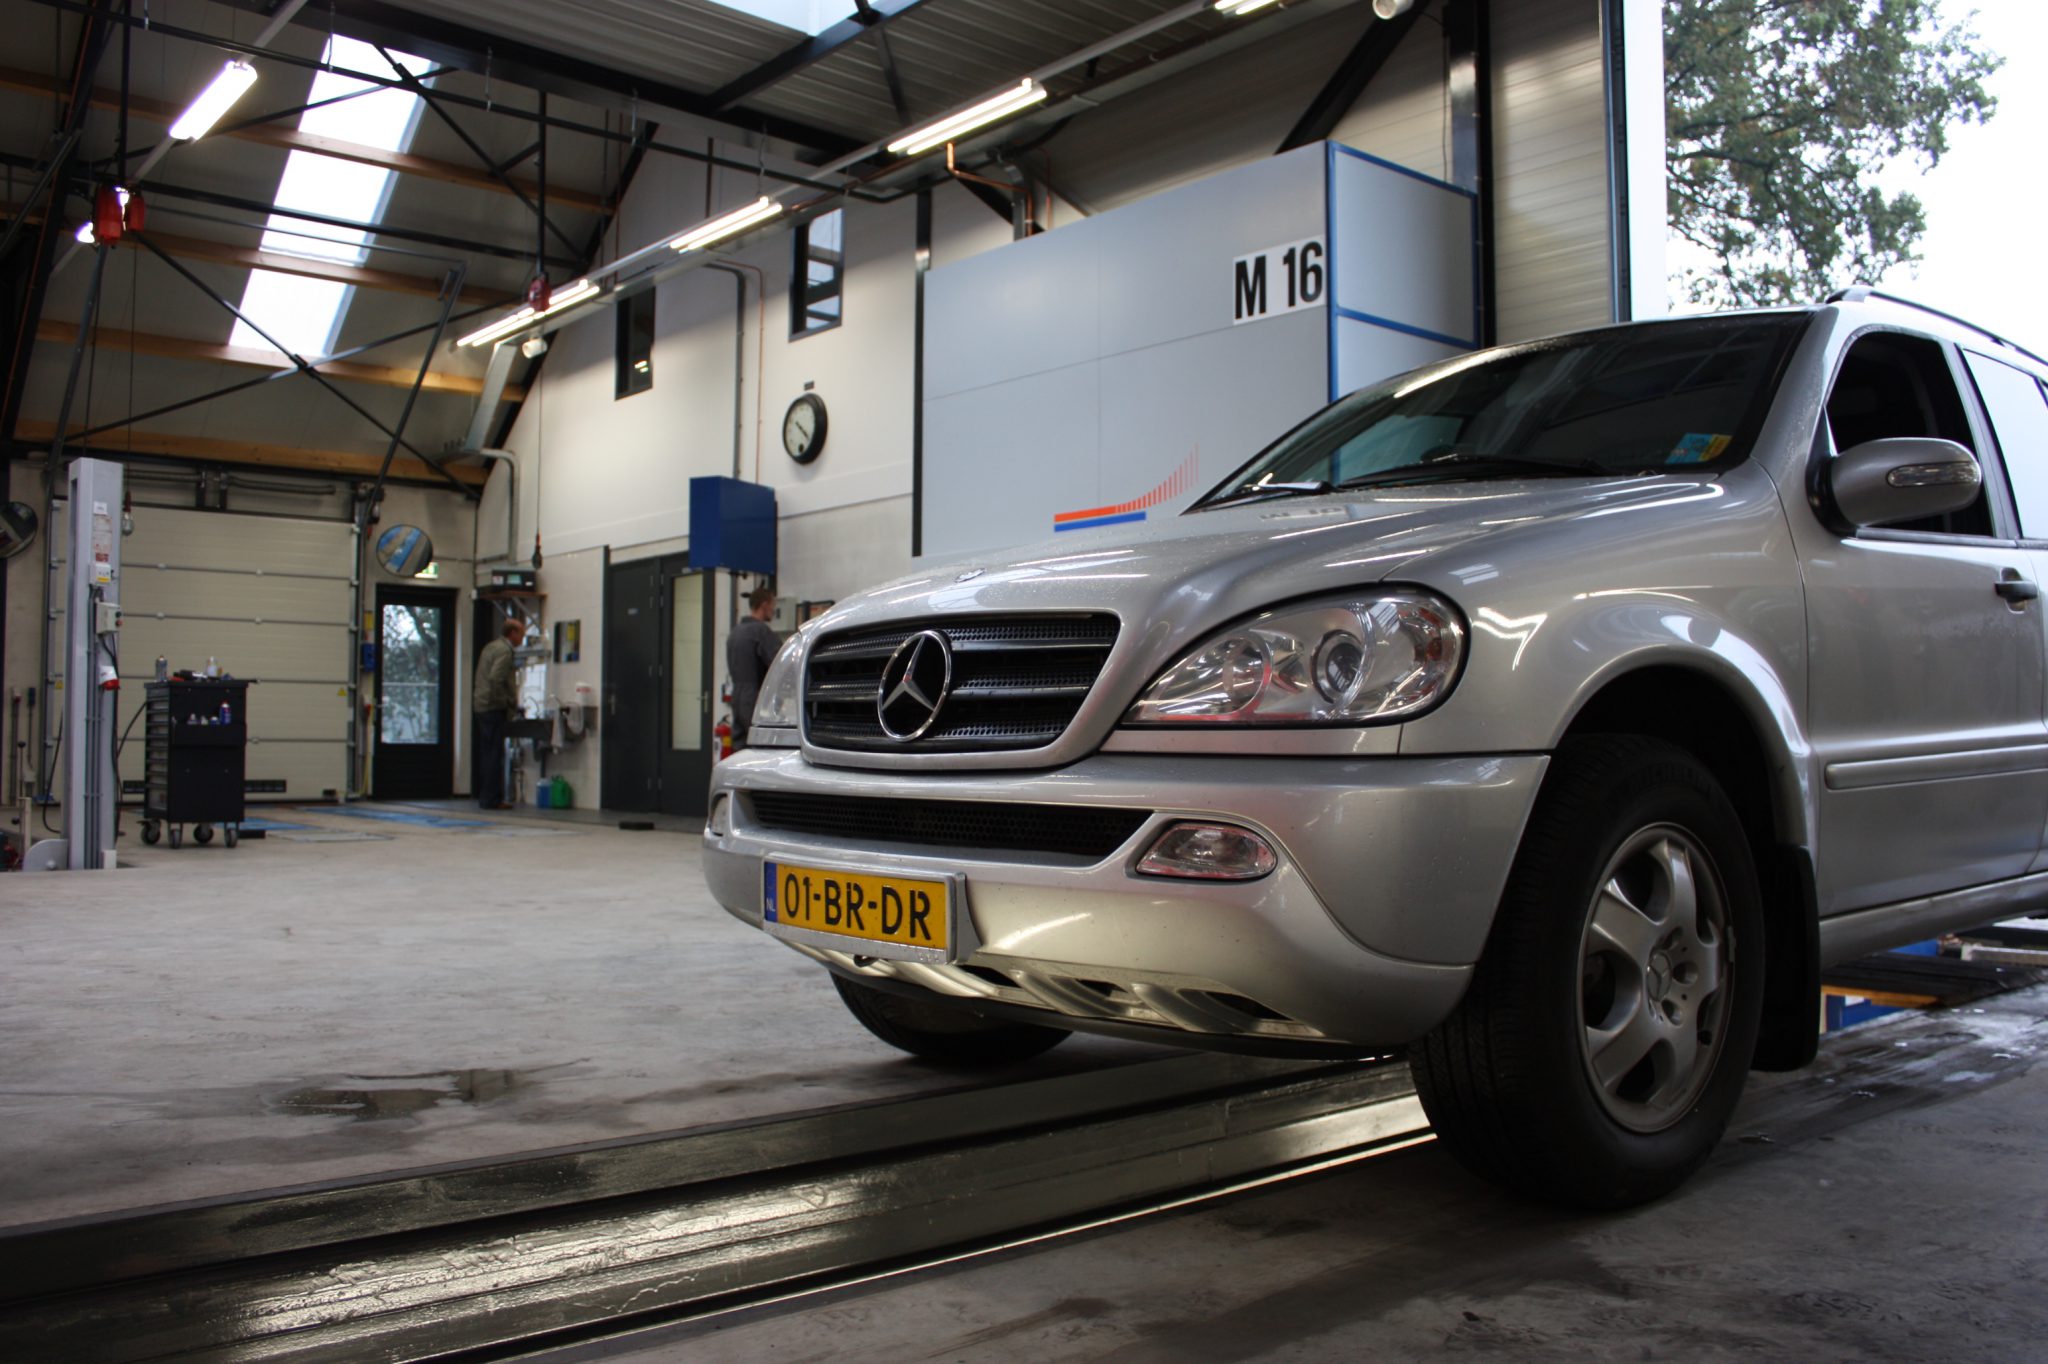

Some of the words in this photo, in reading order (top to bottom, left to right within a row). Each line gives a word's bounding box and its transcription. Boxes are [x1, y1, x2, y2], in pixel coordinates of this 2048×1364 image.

[1235, 254, 1266, 319] M
[1283, 240, 1323, 307] 16
[766, 898, 776, 912] NL
[785, 873, 931, 941] 01-BR-DR
